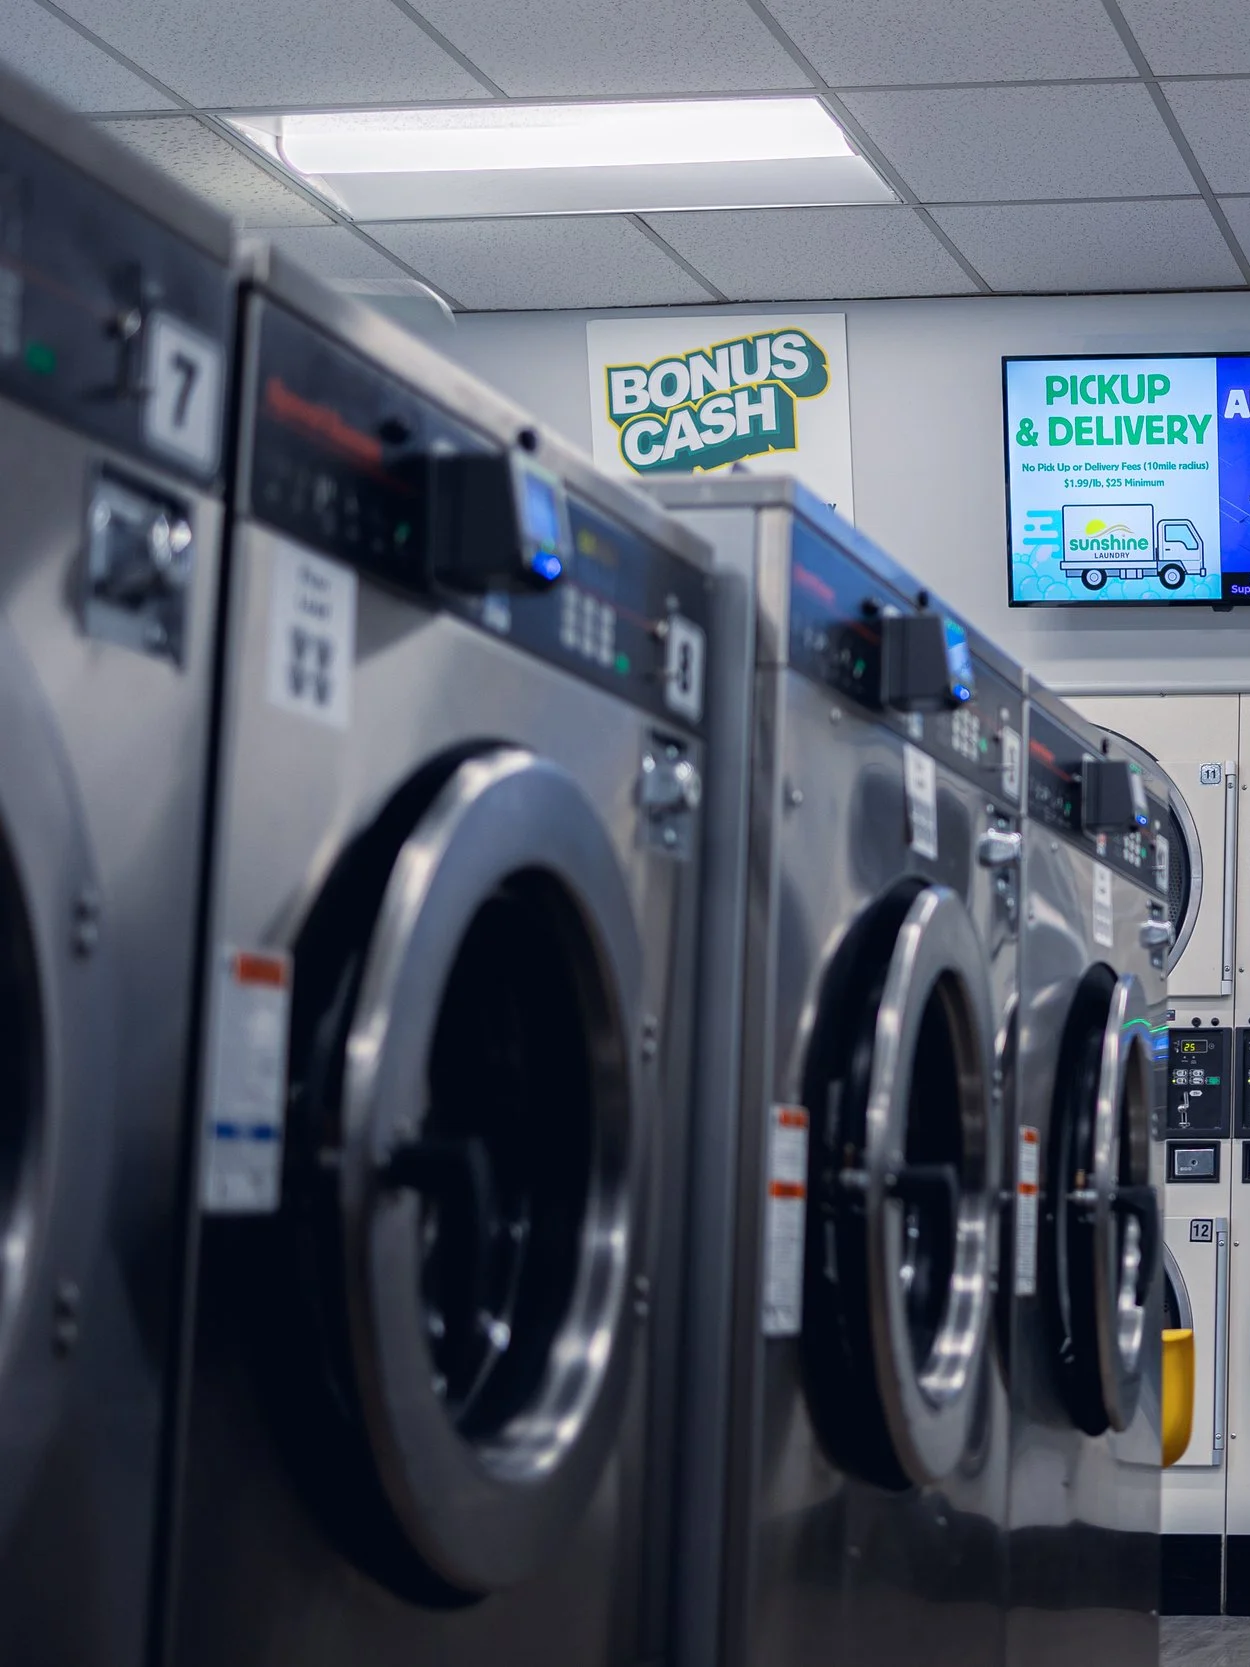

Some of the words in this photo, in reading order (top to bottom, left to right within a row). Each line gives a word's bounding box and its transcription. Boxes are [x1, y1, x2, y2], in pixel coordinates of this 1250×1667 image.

[611, 333, 810, 414] BONUS
[171, 352, 198, 427] 7
[1045, 374, 1171, 405] PICKUP
[624, 386, 776, 466] CASH
[1016, 417, 1039, 447] &
[1048, 414, 1212, 446] DELIVERY
[1022, 463, 1035, 472] No
[1037, 462, 1055, 472] Pick
[1057, 463, 1071, 473] Up
[1084, 462, 1120, 472] Delivery
[1121, 461, 1141, 471] Fees
[1143, 461, 1177, 471] (10mile
[1179, 461, 1209, 471] radius)
[1064, 478, 1104, 489] $1.99/lb,
[1106, 478, 1122, 488] $25
[1124, 478, 1165, 487] Minimum
[1069, 534, 1149, 551] sunshine
[1205, 769, 1216, 779] 11
[1183, 1043, 1196, 1052] 25
[1193, 1224, 1209, 1237] 12
